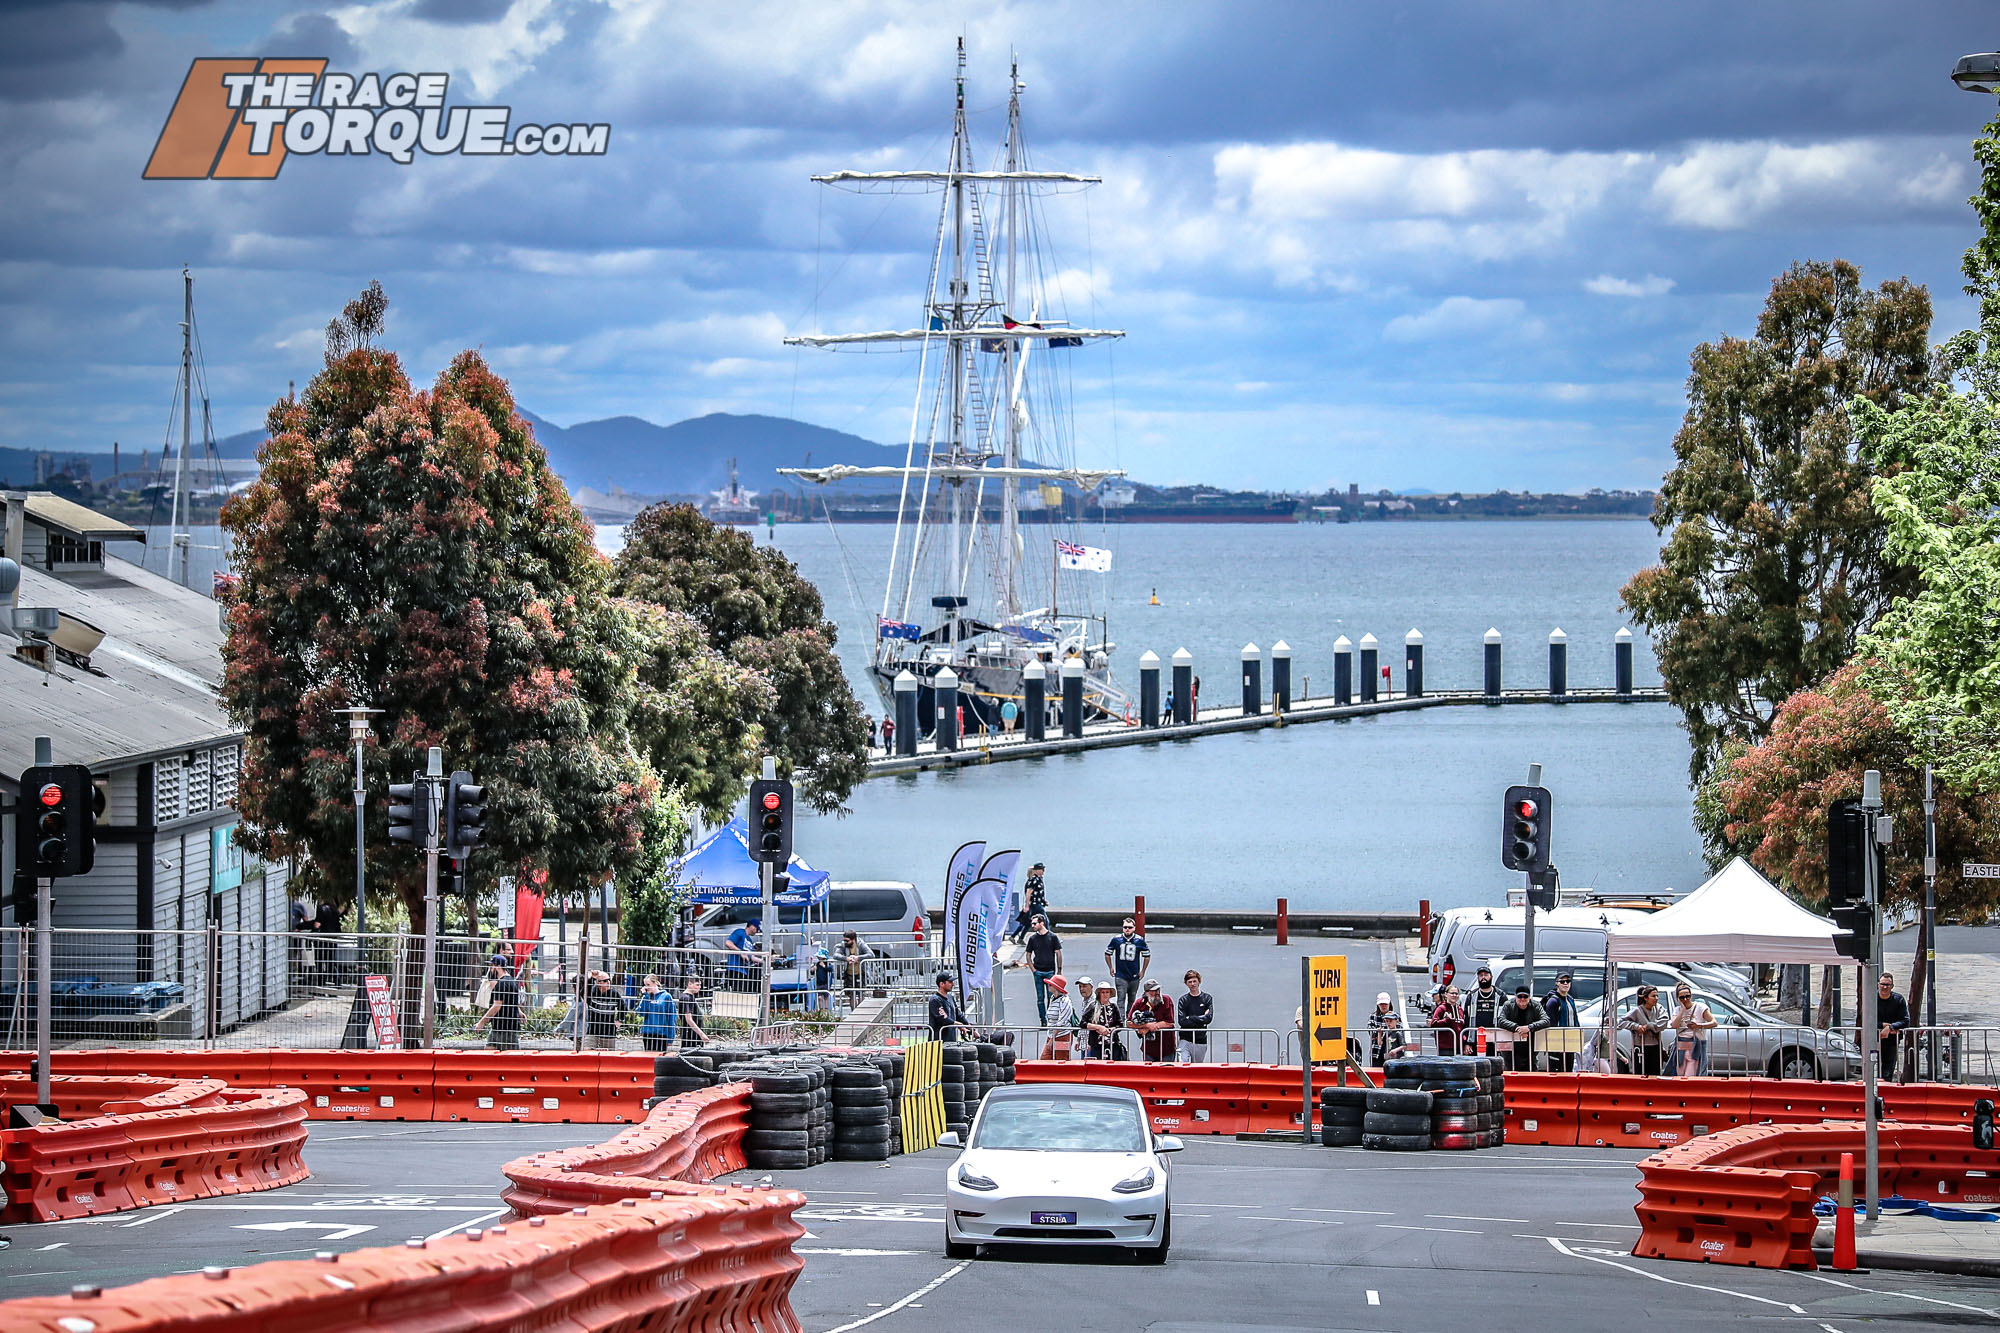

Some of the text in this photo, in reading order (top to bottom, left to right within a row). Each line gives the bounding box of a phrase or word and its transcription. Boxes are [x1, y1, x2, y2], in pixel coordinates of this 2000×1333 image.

[1965, 866, 2000, 876] EASTE
[692, 886, 734, 895] ULTIMATE
[712, 896, 766, 905] HOBBY STOR
[977, 895, 990, 950] DIRECT
[965, 911, 979, 975] HOBBIES
[1119, 943, 1137, 961] 19
[1313, 968, 1341, 989] TURN
[369, 990, 391, 1004] OPEN
[1314, 996, 1340, 1016] LEFT
[503, 1105, 530, 1114] Coates
[1153, 1116, 1180, 1125] Coates
[1650, 1131, 1678, 1140] Coates
[1700, 1239, 1725, 1251] Coates
